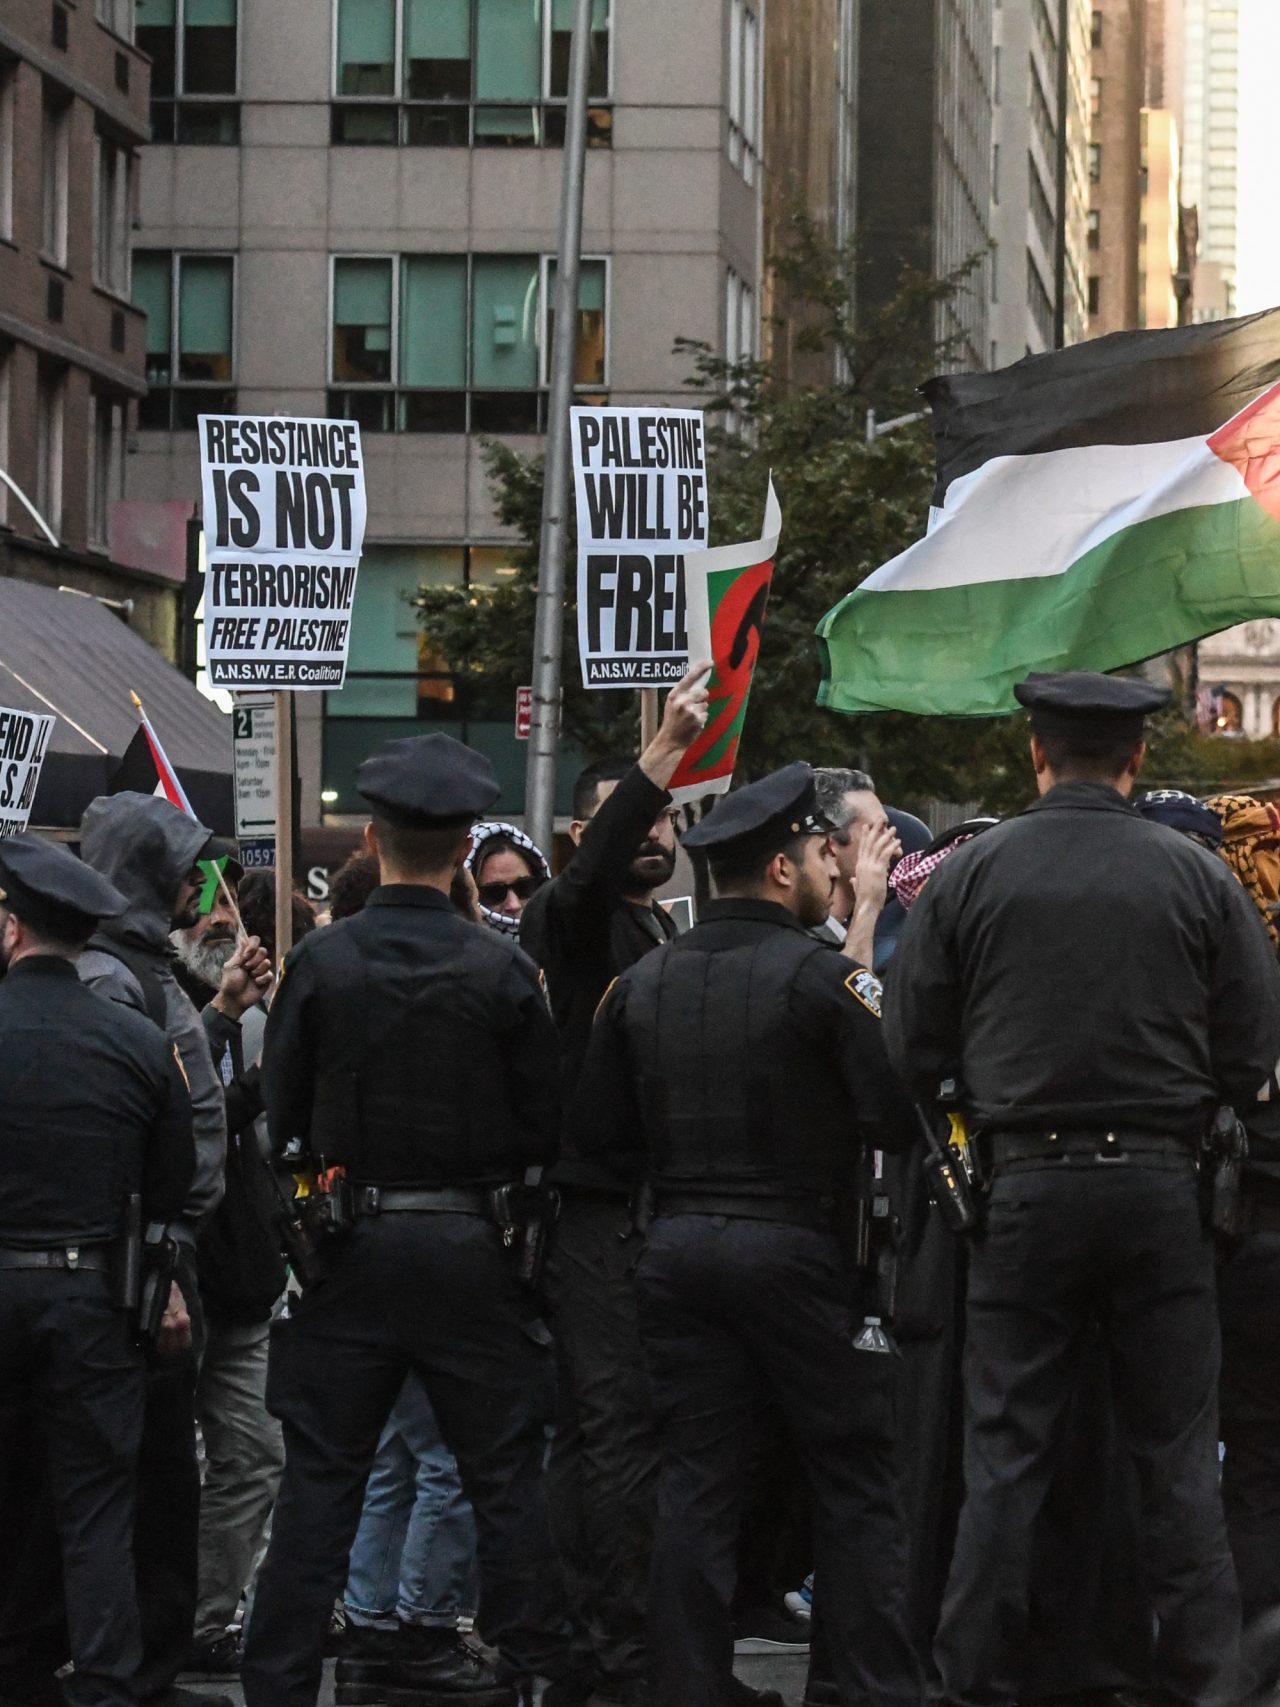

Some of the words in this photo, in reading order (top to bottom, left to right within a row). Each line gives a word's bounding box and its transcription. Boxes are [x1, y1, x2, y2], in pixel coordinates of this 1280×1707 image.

[205, 419, 359, 469] RESISTANCE
[578, 416, 704, 469] PALESTINE
[212, 469, 261, 548] IS
[275, 471, 356, 550] NOT
[584, 473, 671, 539] WILL
[677, 475, 705, 540] BE
[211, 563, 356, 609] TERRORISM!
[209, 617, 262, 650] FREE
[261, 618, 349, 652] PALESTINE!
[299, 665, 341, 681] Coalition
[663, 662, 689, 677] Coalit
[237, 711, 248, 737] 2
